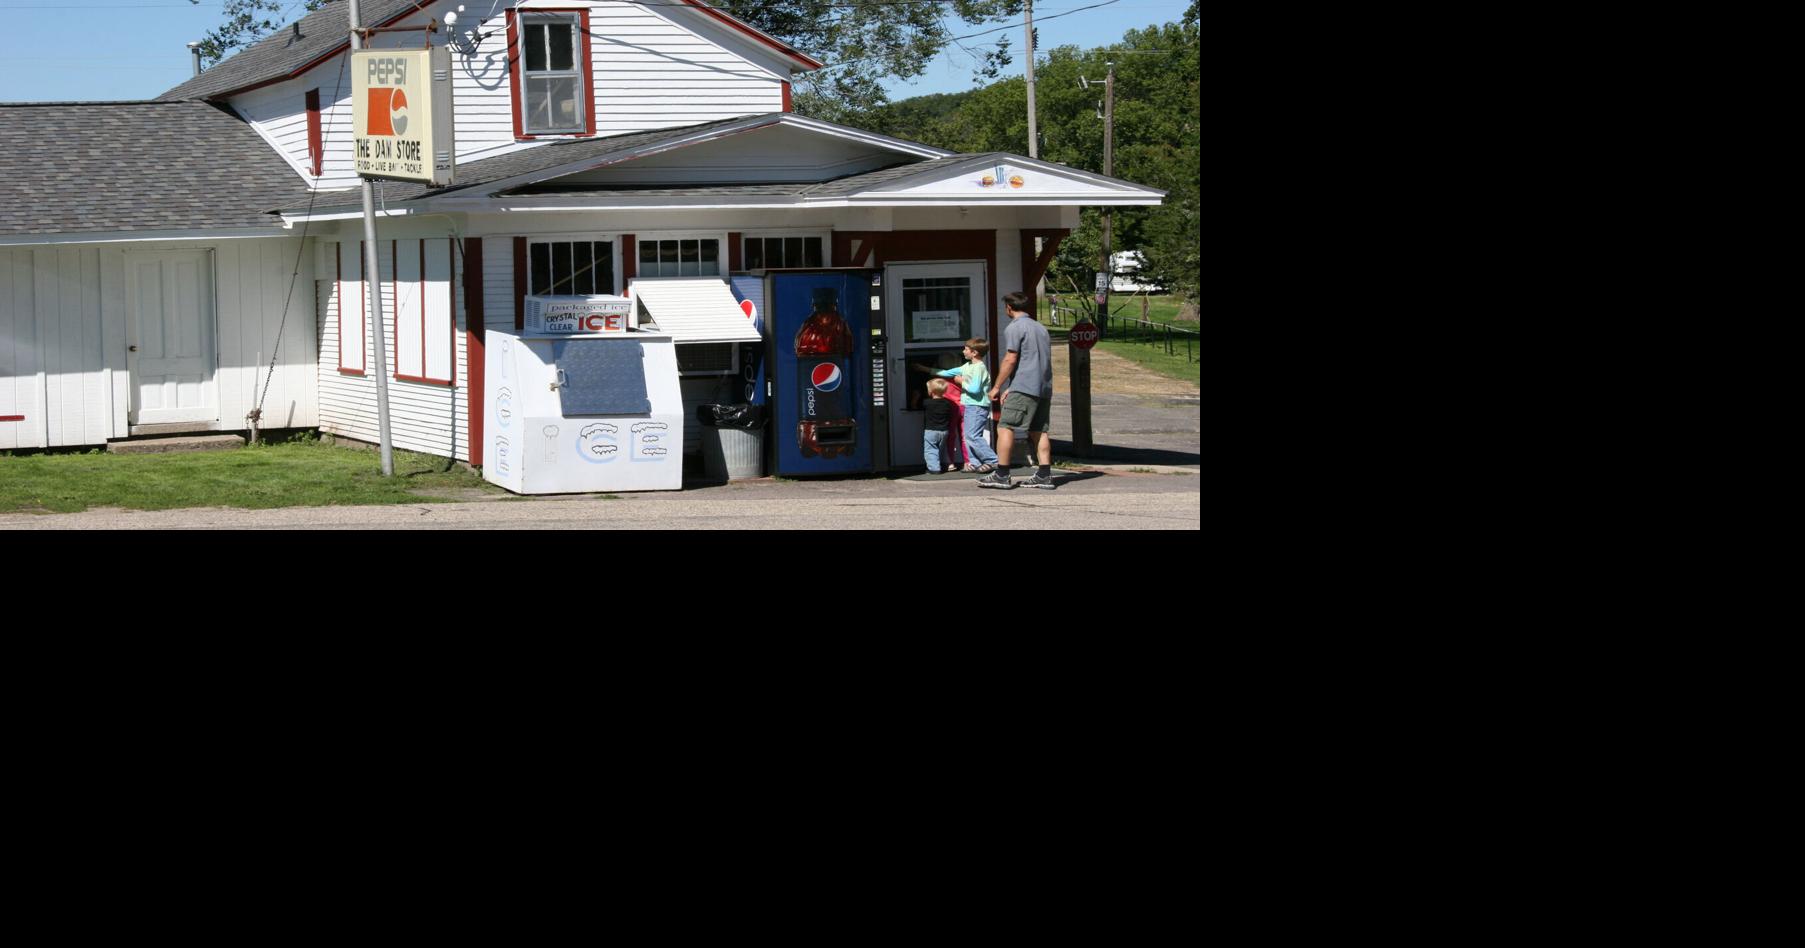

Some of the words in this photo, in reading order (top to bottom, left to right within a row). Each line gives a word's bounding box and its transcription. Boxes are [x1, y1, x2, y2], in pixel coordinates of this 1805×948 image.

[368, 58, 408, 85] PEPSI
[355, 138, 370, 158] THE
[375, 139, 392, 159] DAM
[396, 140, 421, 161] STORE
[357, 160, 371, 170] FOOD
[375, 161, 386, 172] LIVE
[388, 162, 400, 172] BA
[404, 163, 422, 174] TACKLE
[551, 303, 607, 312] packaged
[610, 303, 626, 311] ice
[546, 312, 578, 323] CRYSTAL
[578, 313, 621, 331] ICE
[549, 323, 573, 331] CLEAR
[1071, 330, 1097, 340] STOP
[807, 388, 816, 416] pepsi
